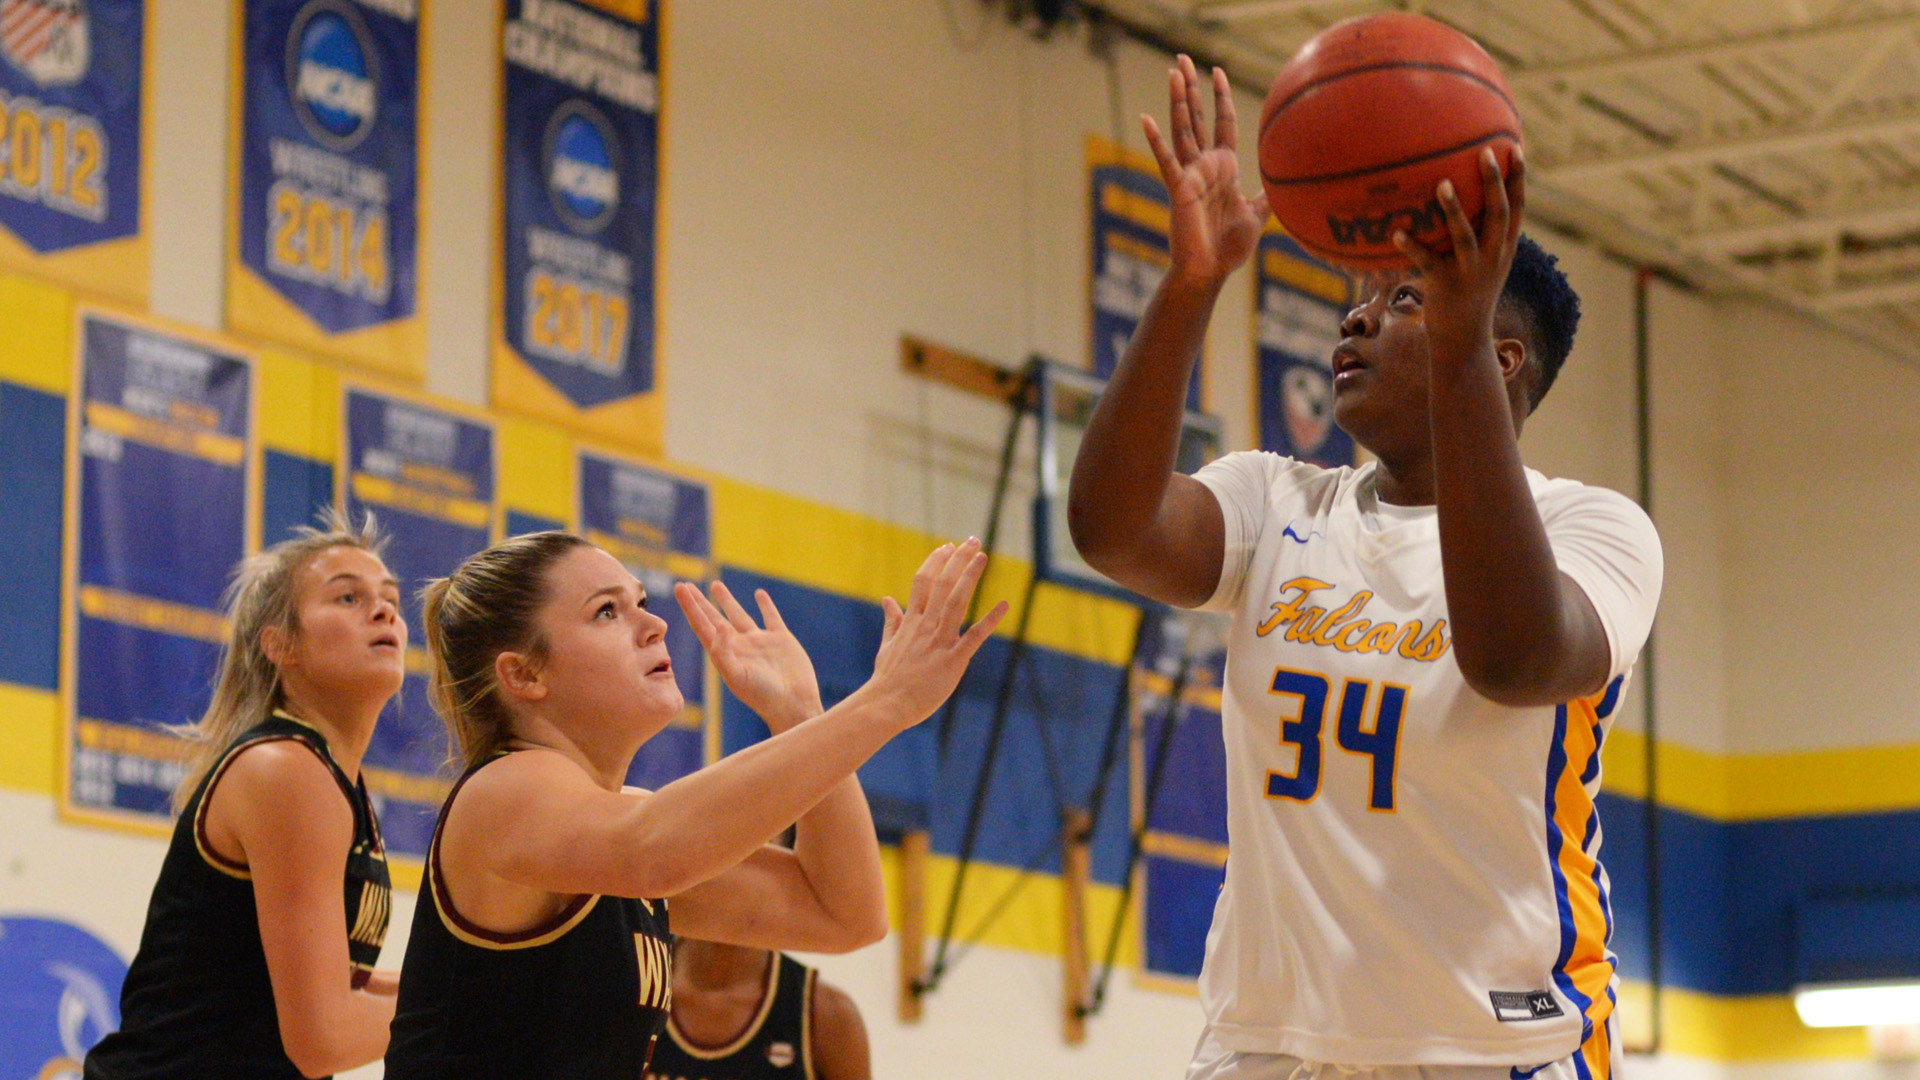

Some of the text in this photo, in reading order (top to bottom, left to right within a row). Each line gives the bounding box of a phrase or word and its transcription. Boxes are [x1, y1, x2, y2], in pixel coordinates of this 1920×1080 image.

[270, 182, 389, 299] 2014
[526, 268, 631, 373] 2017
[1256, 576, 1452, 662] Falcons
[1263, 665, 1411, 814] 34
[1533, 997, 1554, 1012] XL
